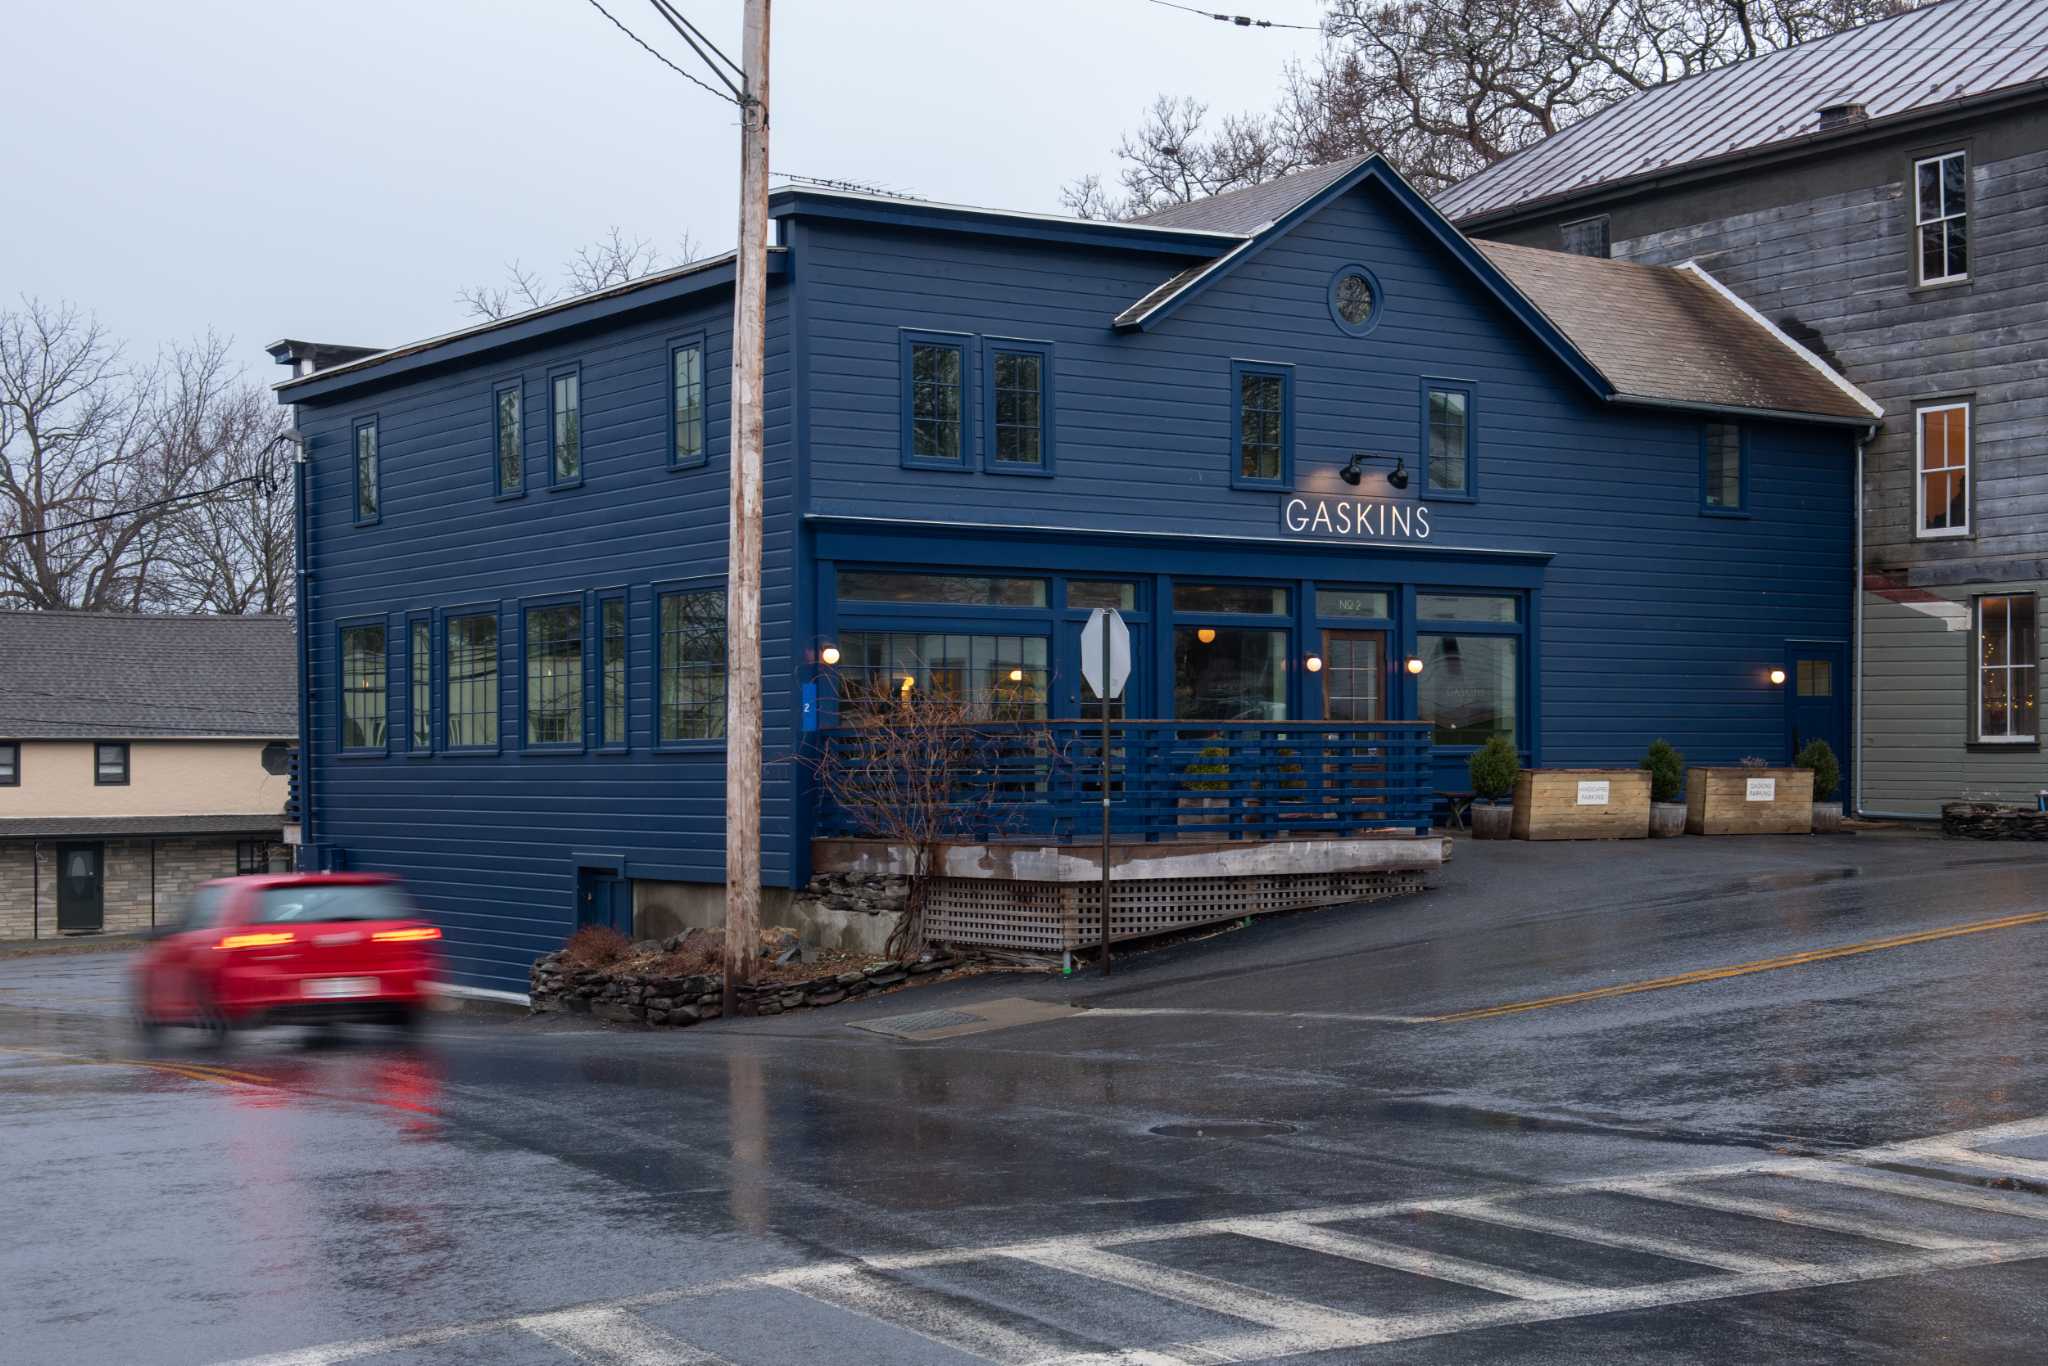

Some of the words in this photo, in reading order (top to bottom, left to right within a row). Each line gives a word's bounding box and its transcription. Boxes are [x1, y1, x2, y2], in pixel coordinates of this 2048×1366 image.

[1286, 499, 1430, 538] GASKINS
[1355, 600, 1361, 611] 2
[803, 703, 810, 713] 2
